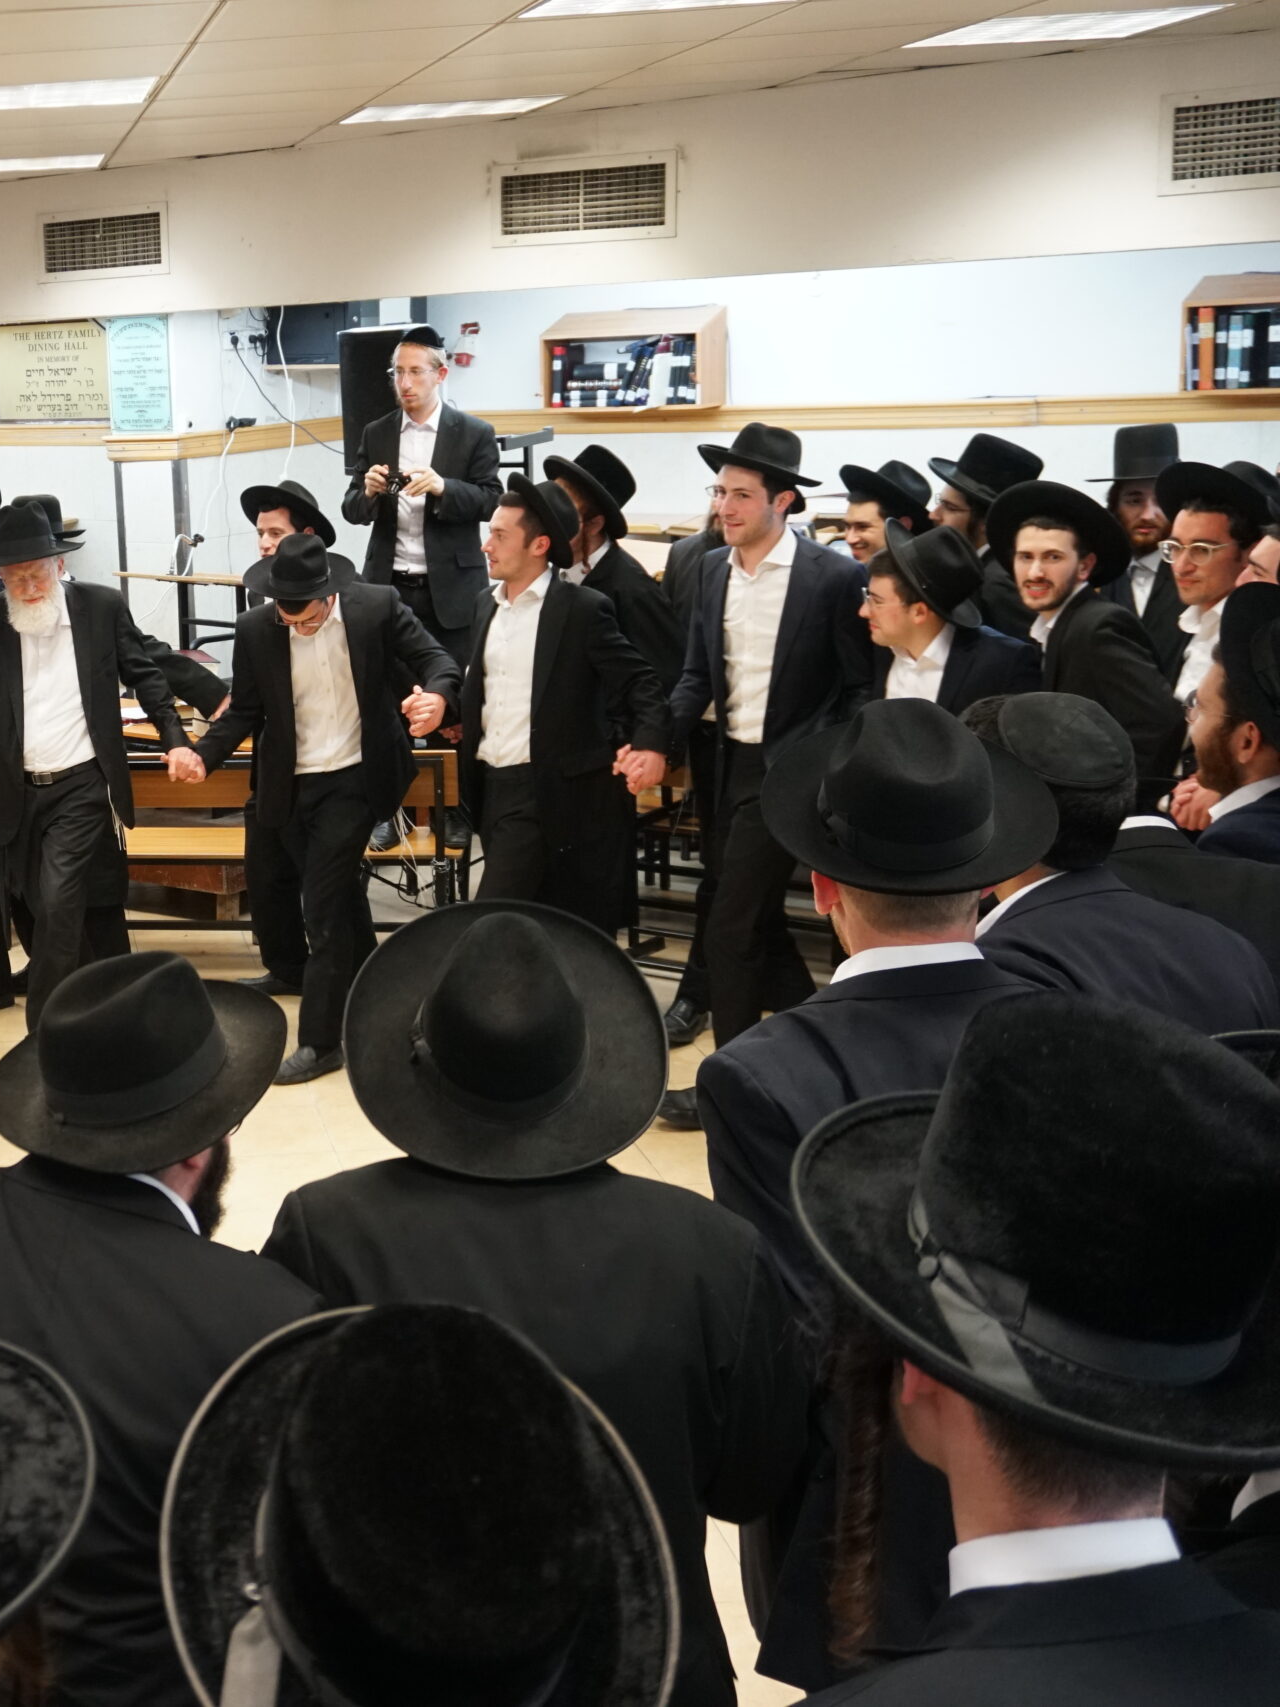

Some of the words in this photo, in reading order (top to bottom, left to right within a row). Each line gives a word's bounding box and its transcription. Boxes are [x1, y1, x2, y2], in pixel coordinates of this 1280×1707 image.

[13, 332, 30, 341] THE
[35, 331, 63, 340] HERTZ
[68, 329, 102, 338] FAMILY
[28, 343, 60, 352] DINING
[65, 341, 88, 350] HALL
[26, 369, 44, 377] חיים
[48, 365, 77, 376] ישראל
[19, 392, 37, 402] לאה
[41, 391, 72, 402] פריידל
[78, 393, 104, 401] ומרת
[37, 403, 63, 411] בעריש
[65, 403, 78, 411] דוב
